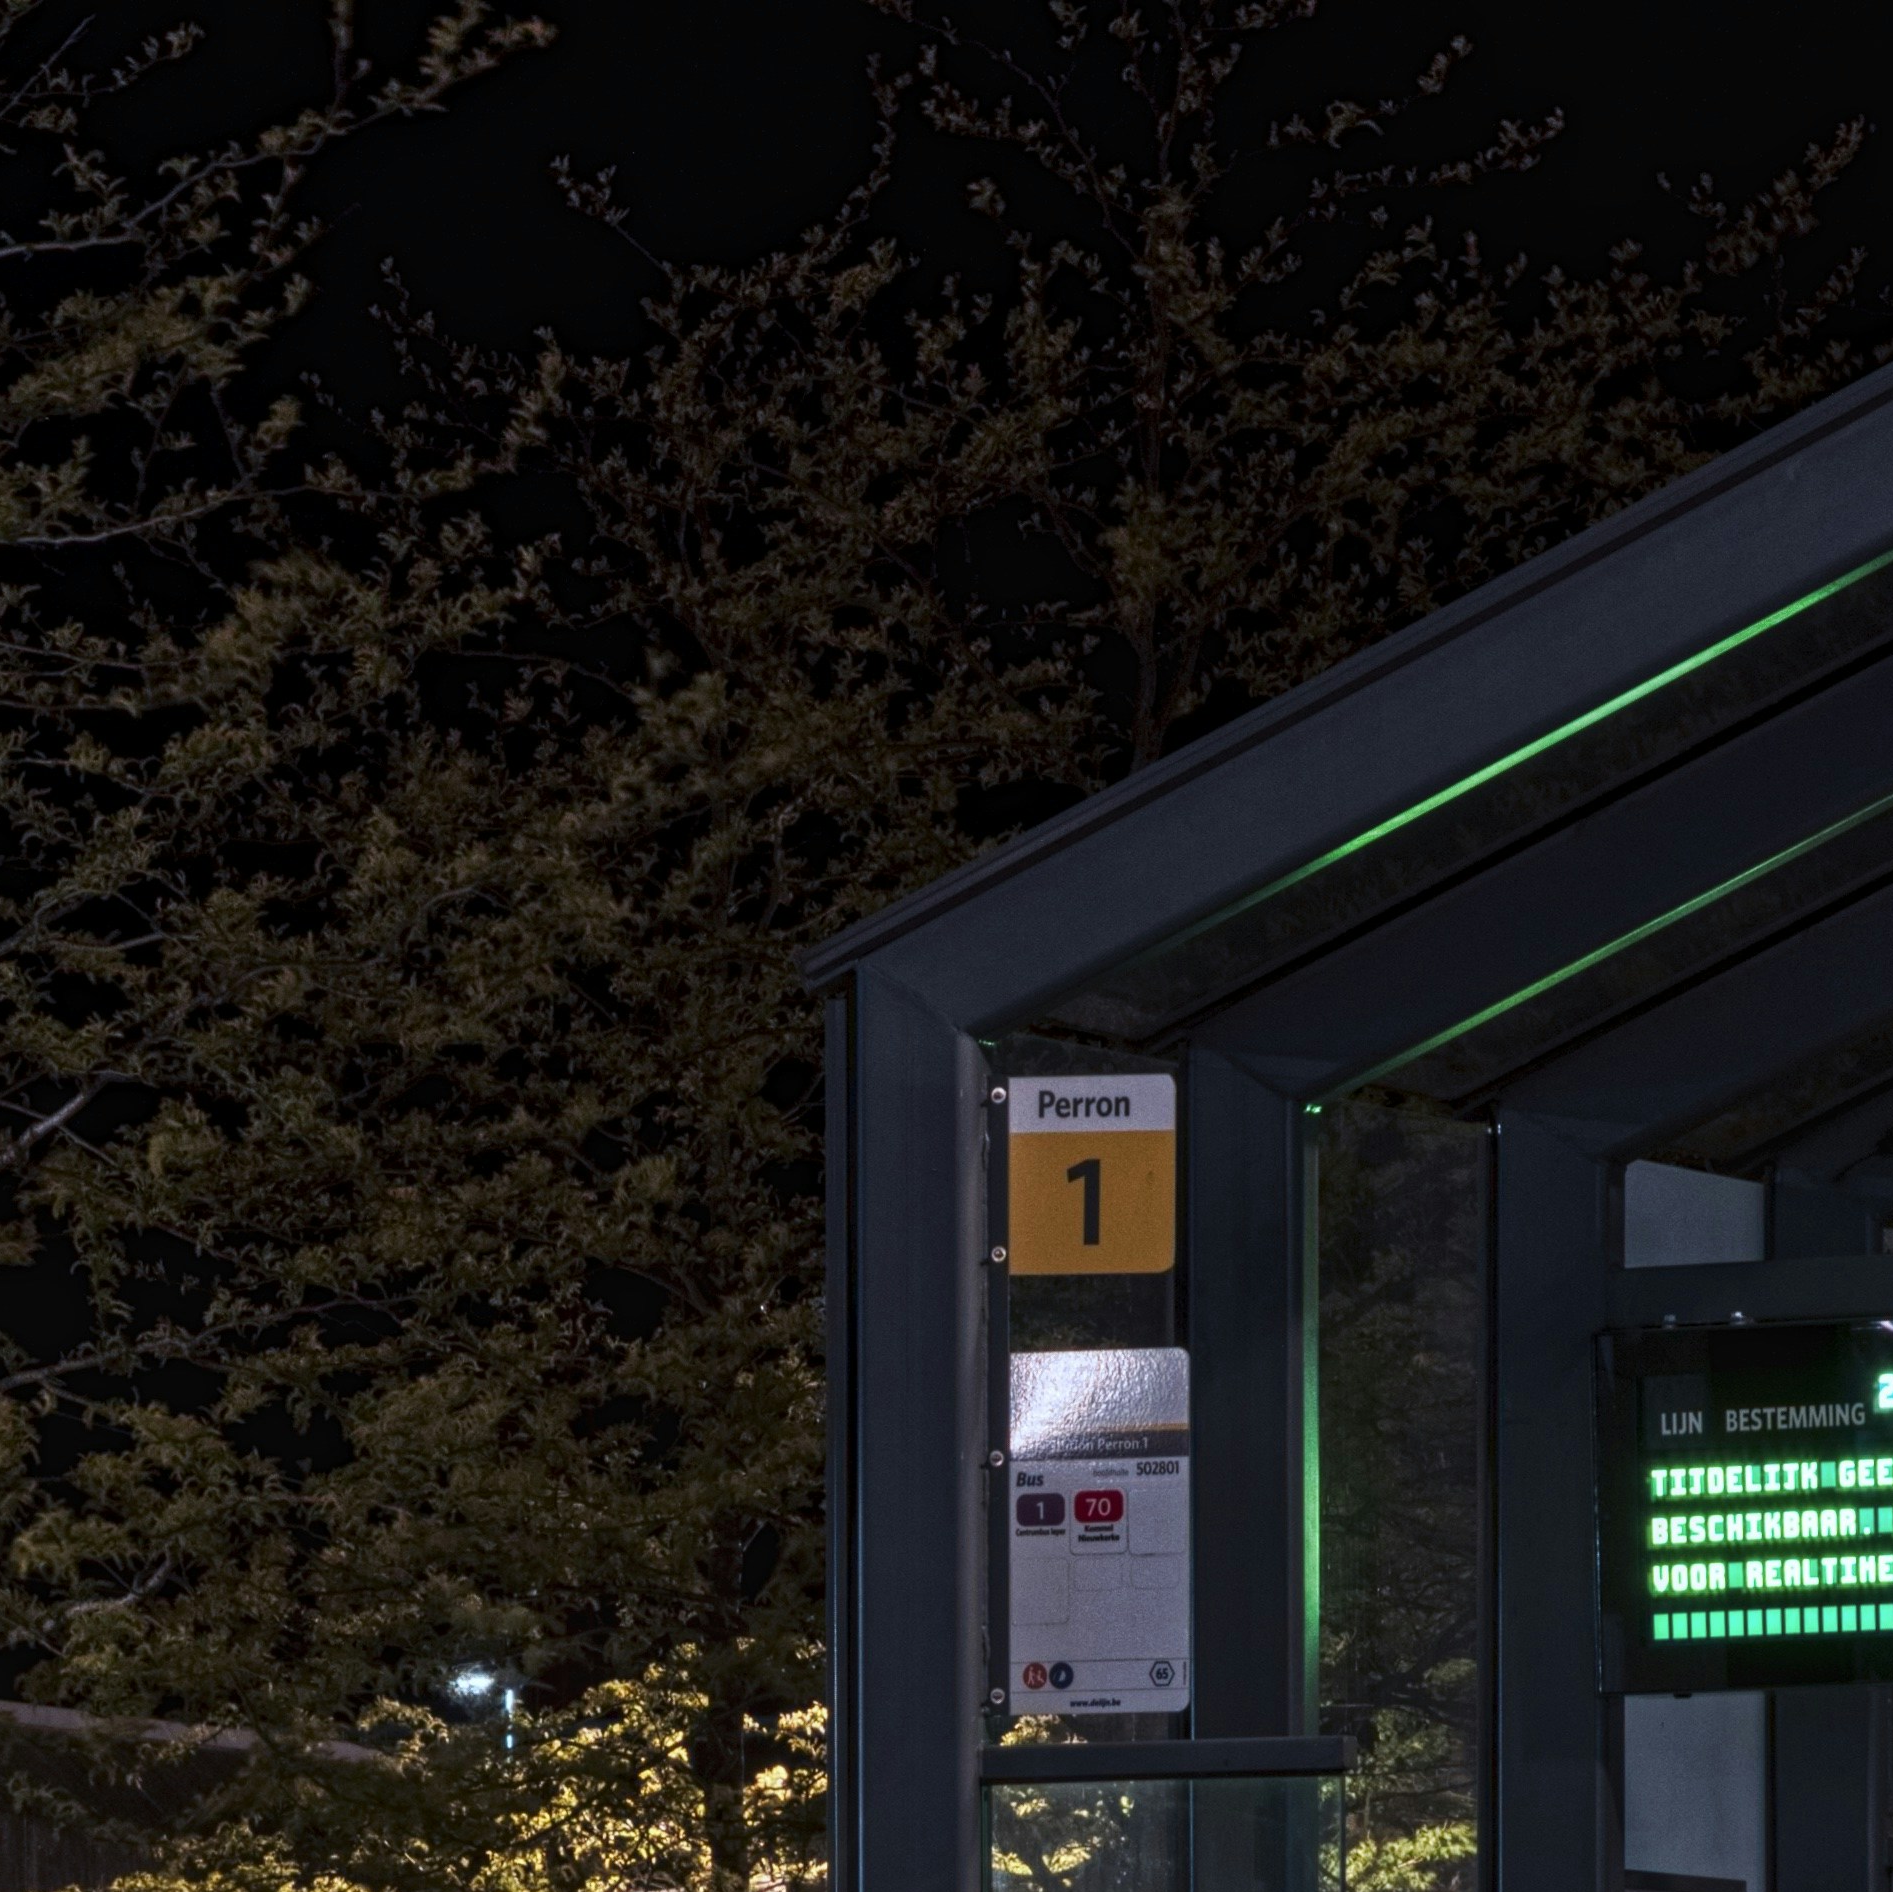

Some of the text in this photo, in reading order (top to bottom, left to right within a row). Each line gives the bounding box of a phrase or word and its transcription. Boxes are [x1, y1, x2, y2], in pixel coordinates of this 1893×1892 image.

[1038, 1090, 1130, 1118] Perron
[1066, 1158, 1101, 1246] 1
[1661, 1411, 1704, 1436] LIJN
[1725, 1402, 1866, 1432] BESTEMMING
[1097, 1438, 1140, 1450] Perron
[1143, 1436, 1149, 1449] 1
[1016, 1472, 1044, 1487] Bus
[1136, 1460, 1180, 1476] 502801
[1651, 1461, 1818, 1497] TIJDELIJK
[1036, 1501, 1044, 1520] 1
[1085, 1498, 1112, 1517] 70
[1651, 1508, 1872, 1545] BESCHIKBAAR.
[1652, 1562, 1726, 1592] VOOR
[1156, 1668, 1169, 1680] 65
